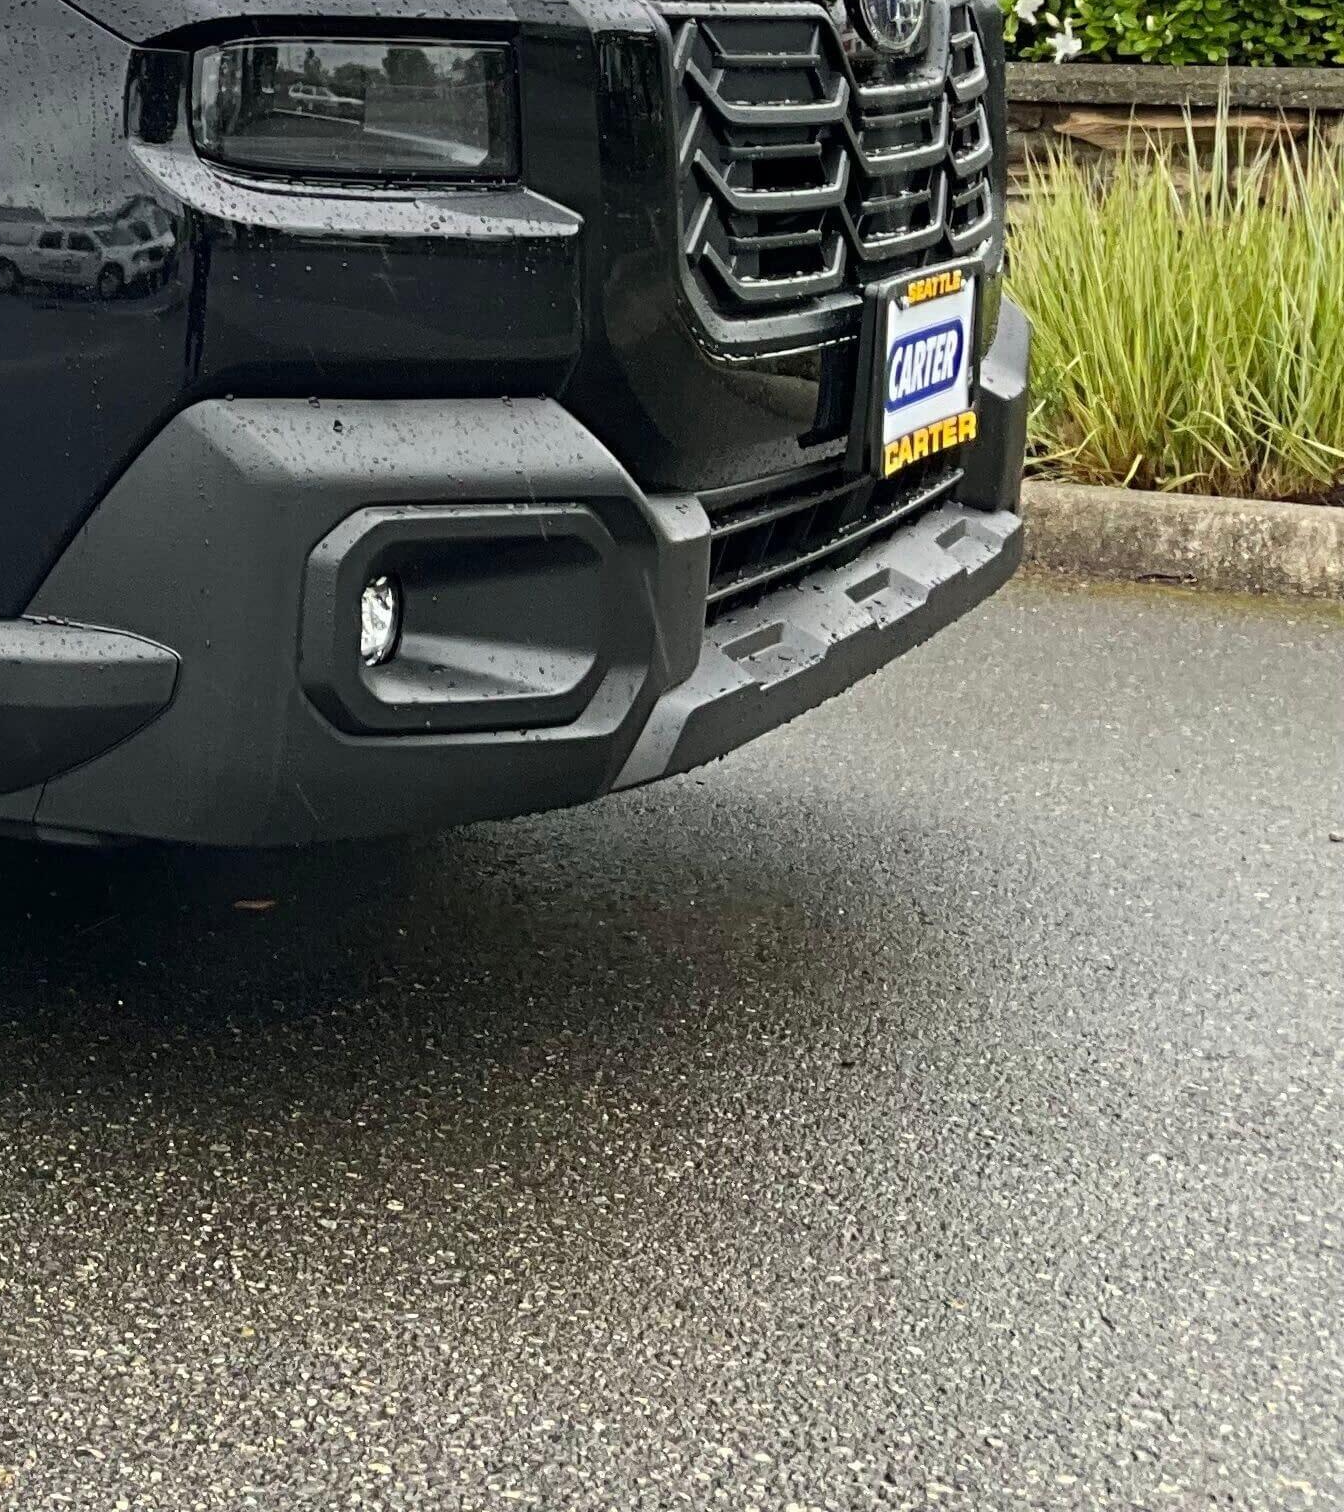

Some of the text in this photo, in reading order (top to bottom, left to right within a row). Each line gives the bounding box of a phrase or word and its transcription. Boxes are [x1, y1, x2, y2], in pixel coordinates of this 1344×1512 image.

[907, 270, 961, 303] SEATTLE
[889, 330, 958, 402] CARTER
[884, 411, 976, 476] CARTER
